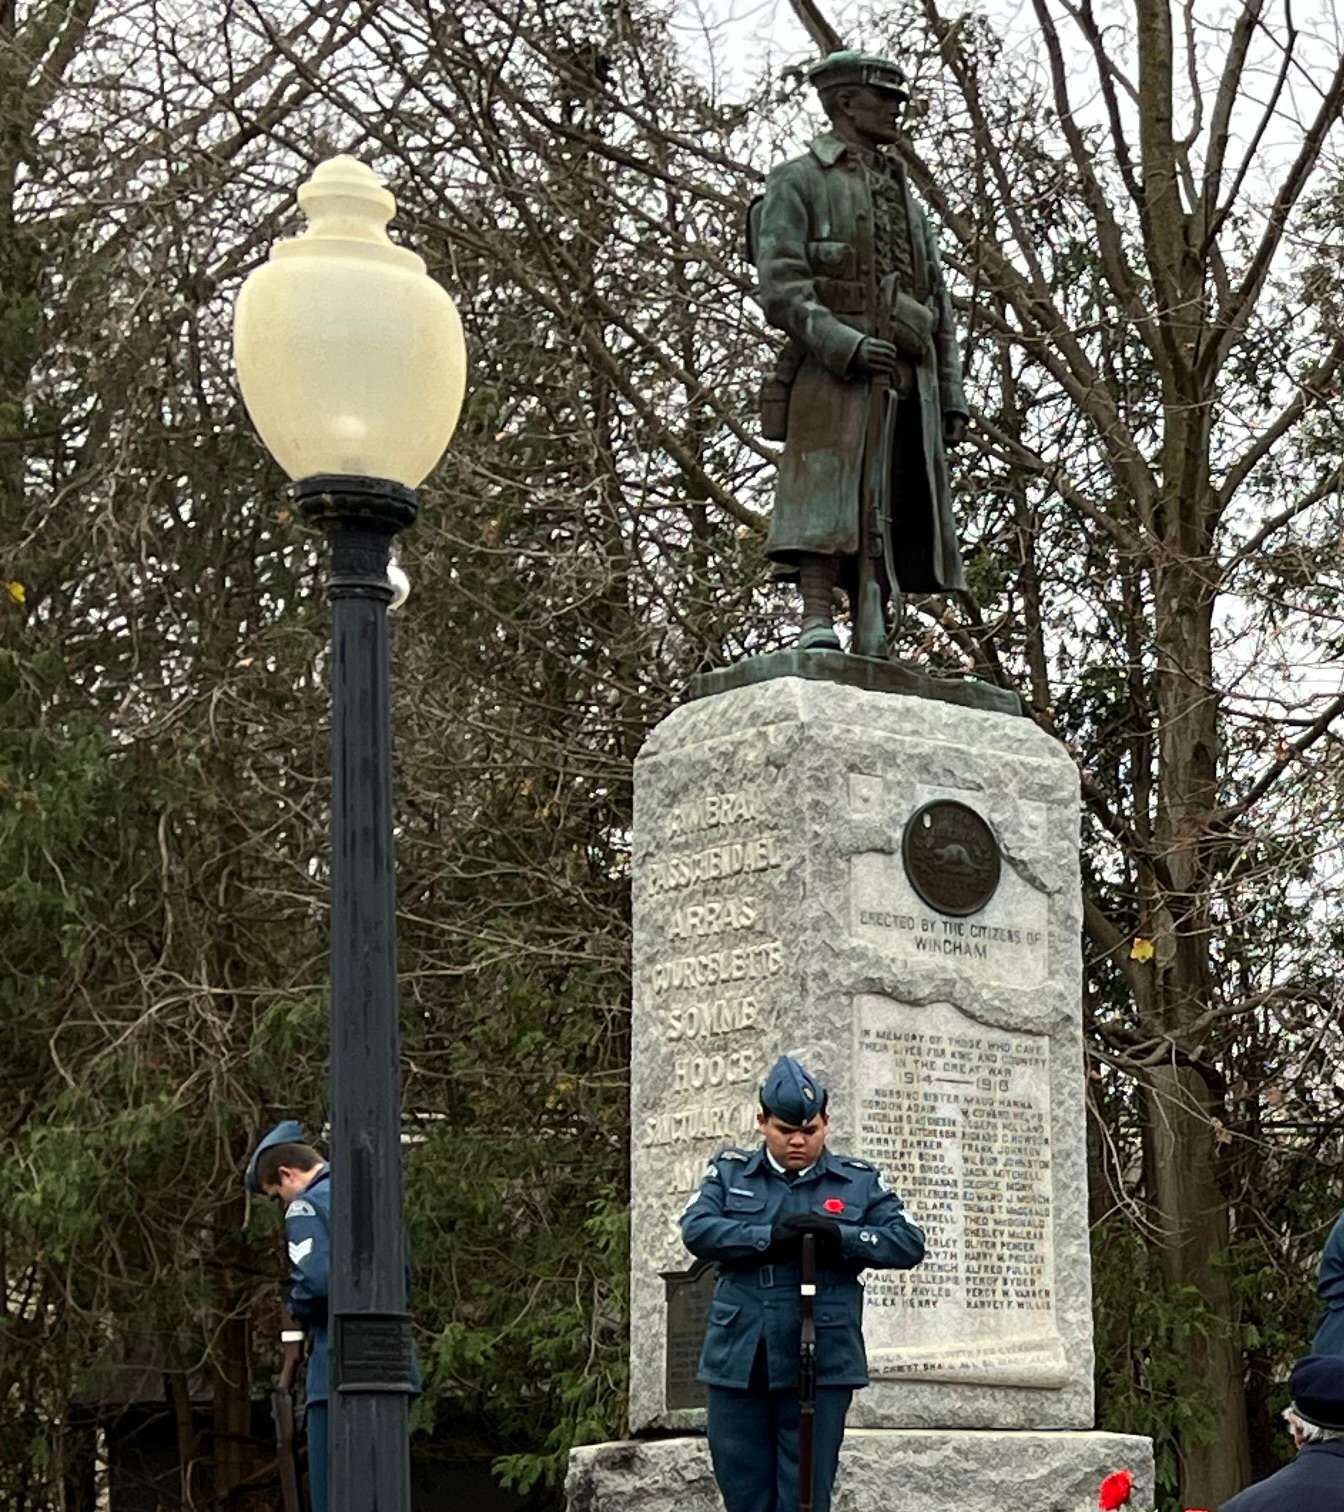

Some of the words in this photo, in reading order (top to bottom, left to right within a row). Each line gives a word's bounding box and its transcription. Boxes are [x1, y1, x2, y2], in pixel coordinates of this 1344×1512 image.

[670, 897, 758, 938] ARRAS
[860, 911, 914, 931] ERECTED
[921, 919, 936, 933] BY
[942, 921, 964, 936] THE
[971, 925, 1021, 944] CITIZENS
[1026, 931, 1041, 946] OF
[667, 996, 757, 1039] SOMME
[876, 1030, 924, 1043] MEMORY
[948, 1037, 981, 1049] THOSE
[866, 1272, 894, 1283] PAUL
